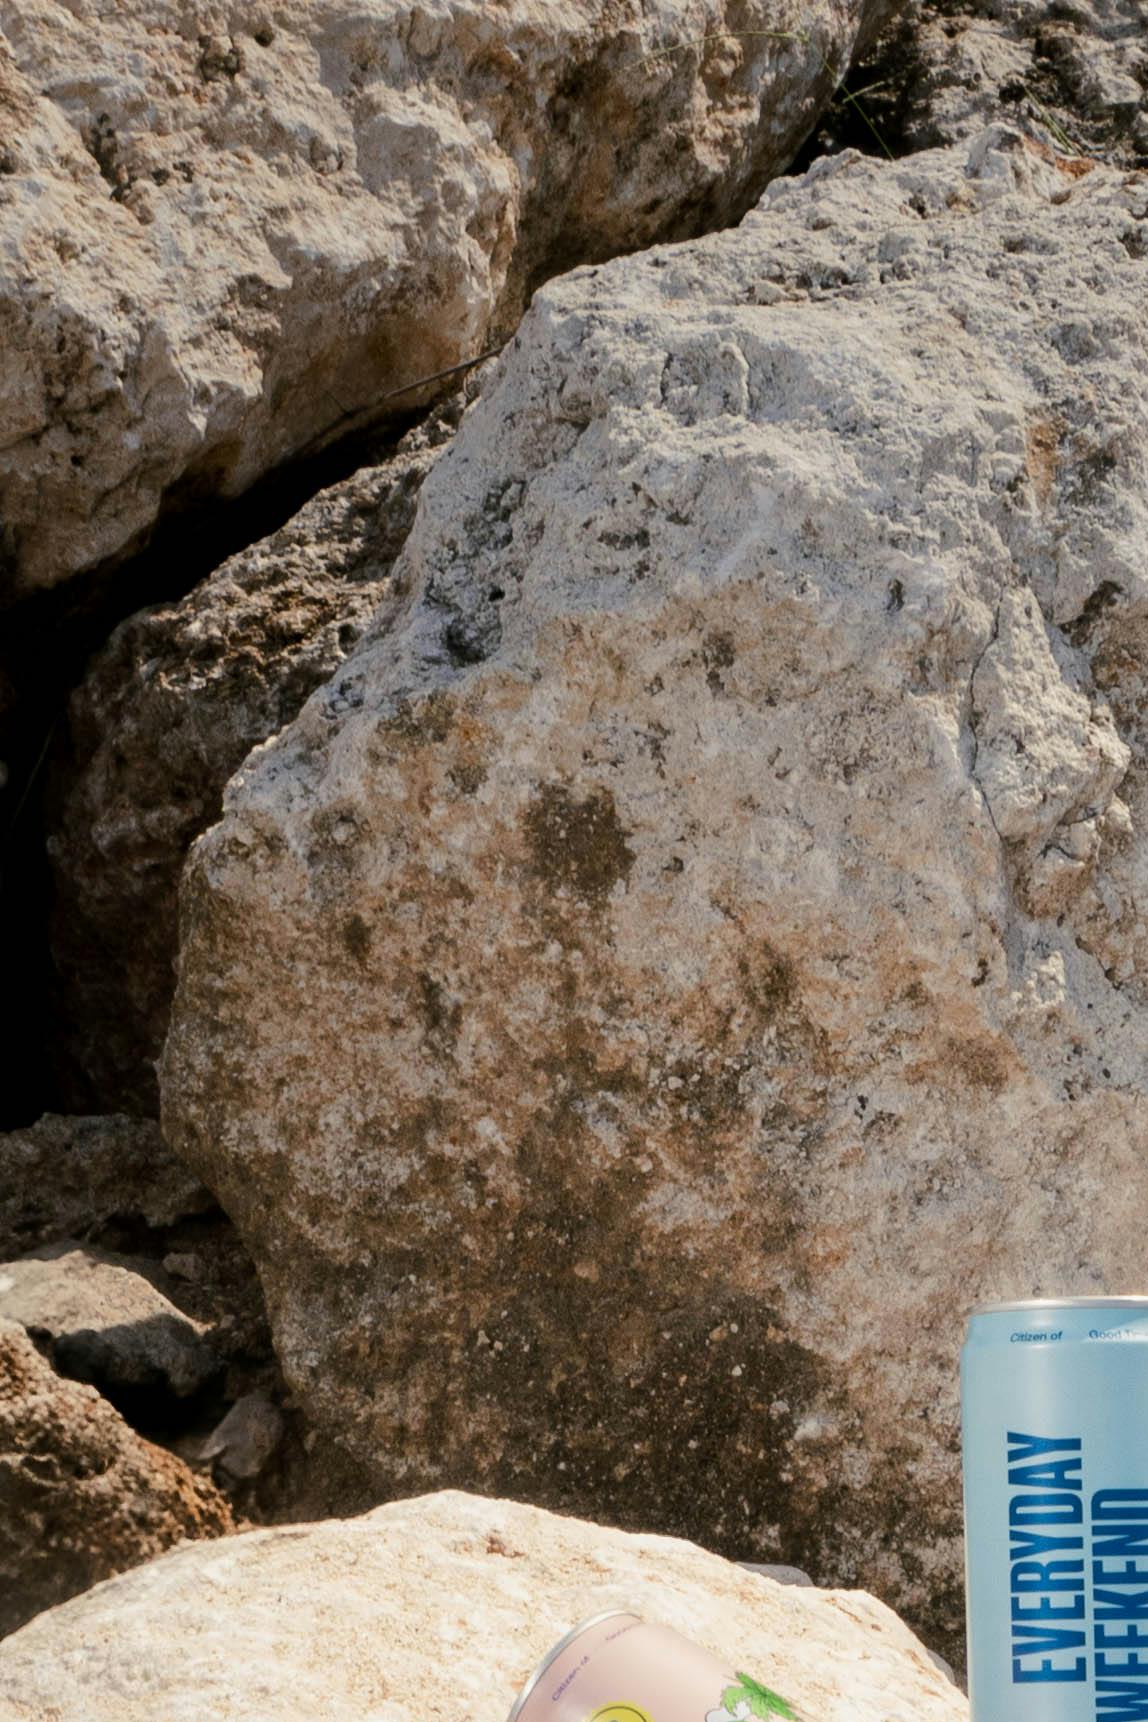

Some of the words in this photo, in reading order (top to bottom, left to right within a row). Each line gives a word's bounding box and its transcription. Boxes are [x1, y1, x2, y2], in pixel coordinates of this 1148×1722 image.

[1010, 1331, 1047, 1343] Citizen
[1050, 1331, 1063, 1340] of
[1007, 1431, 1087, 1684] EVERYDAY
